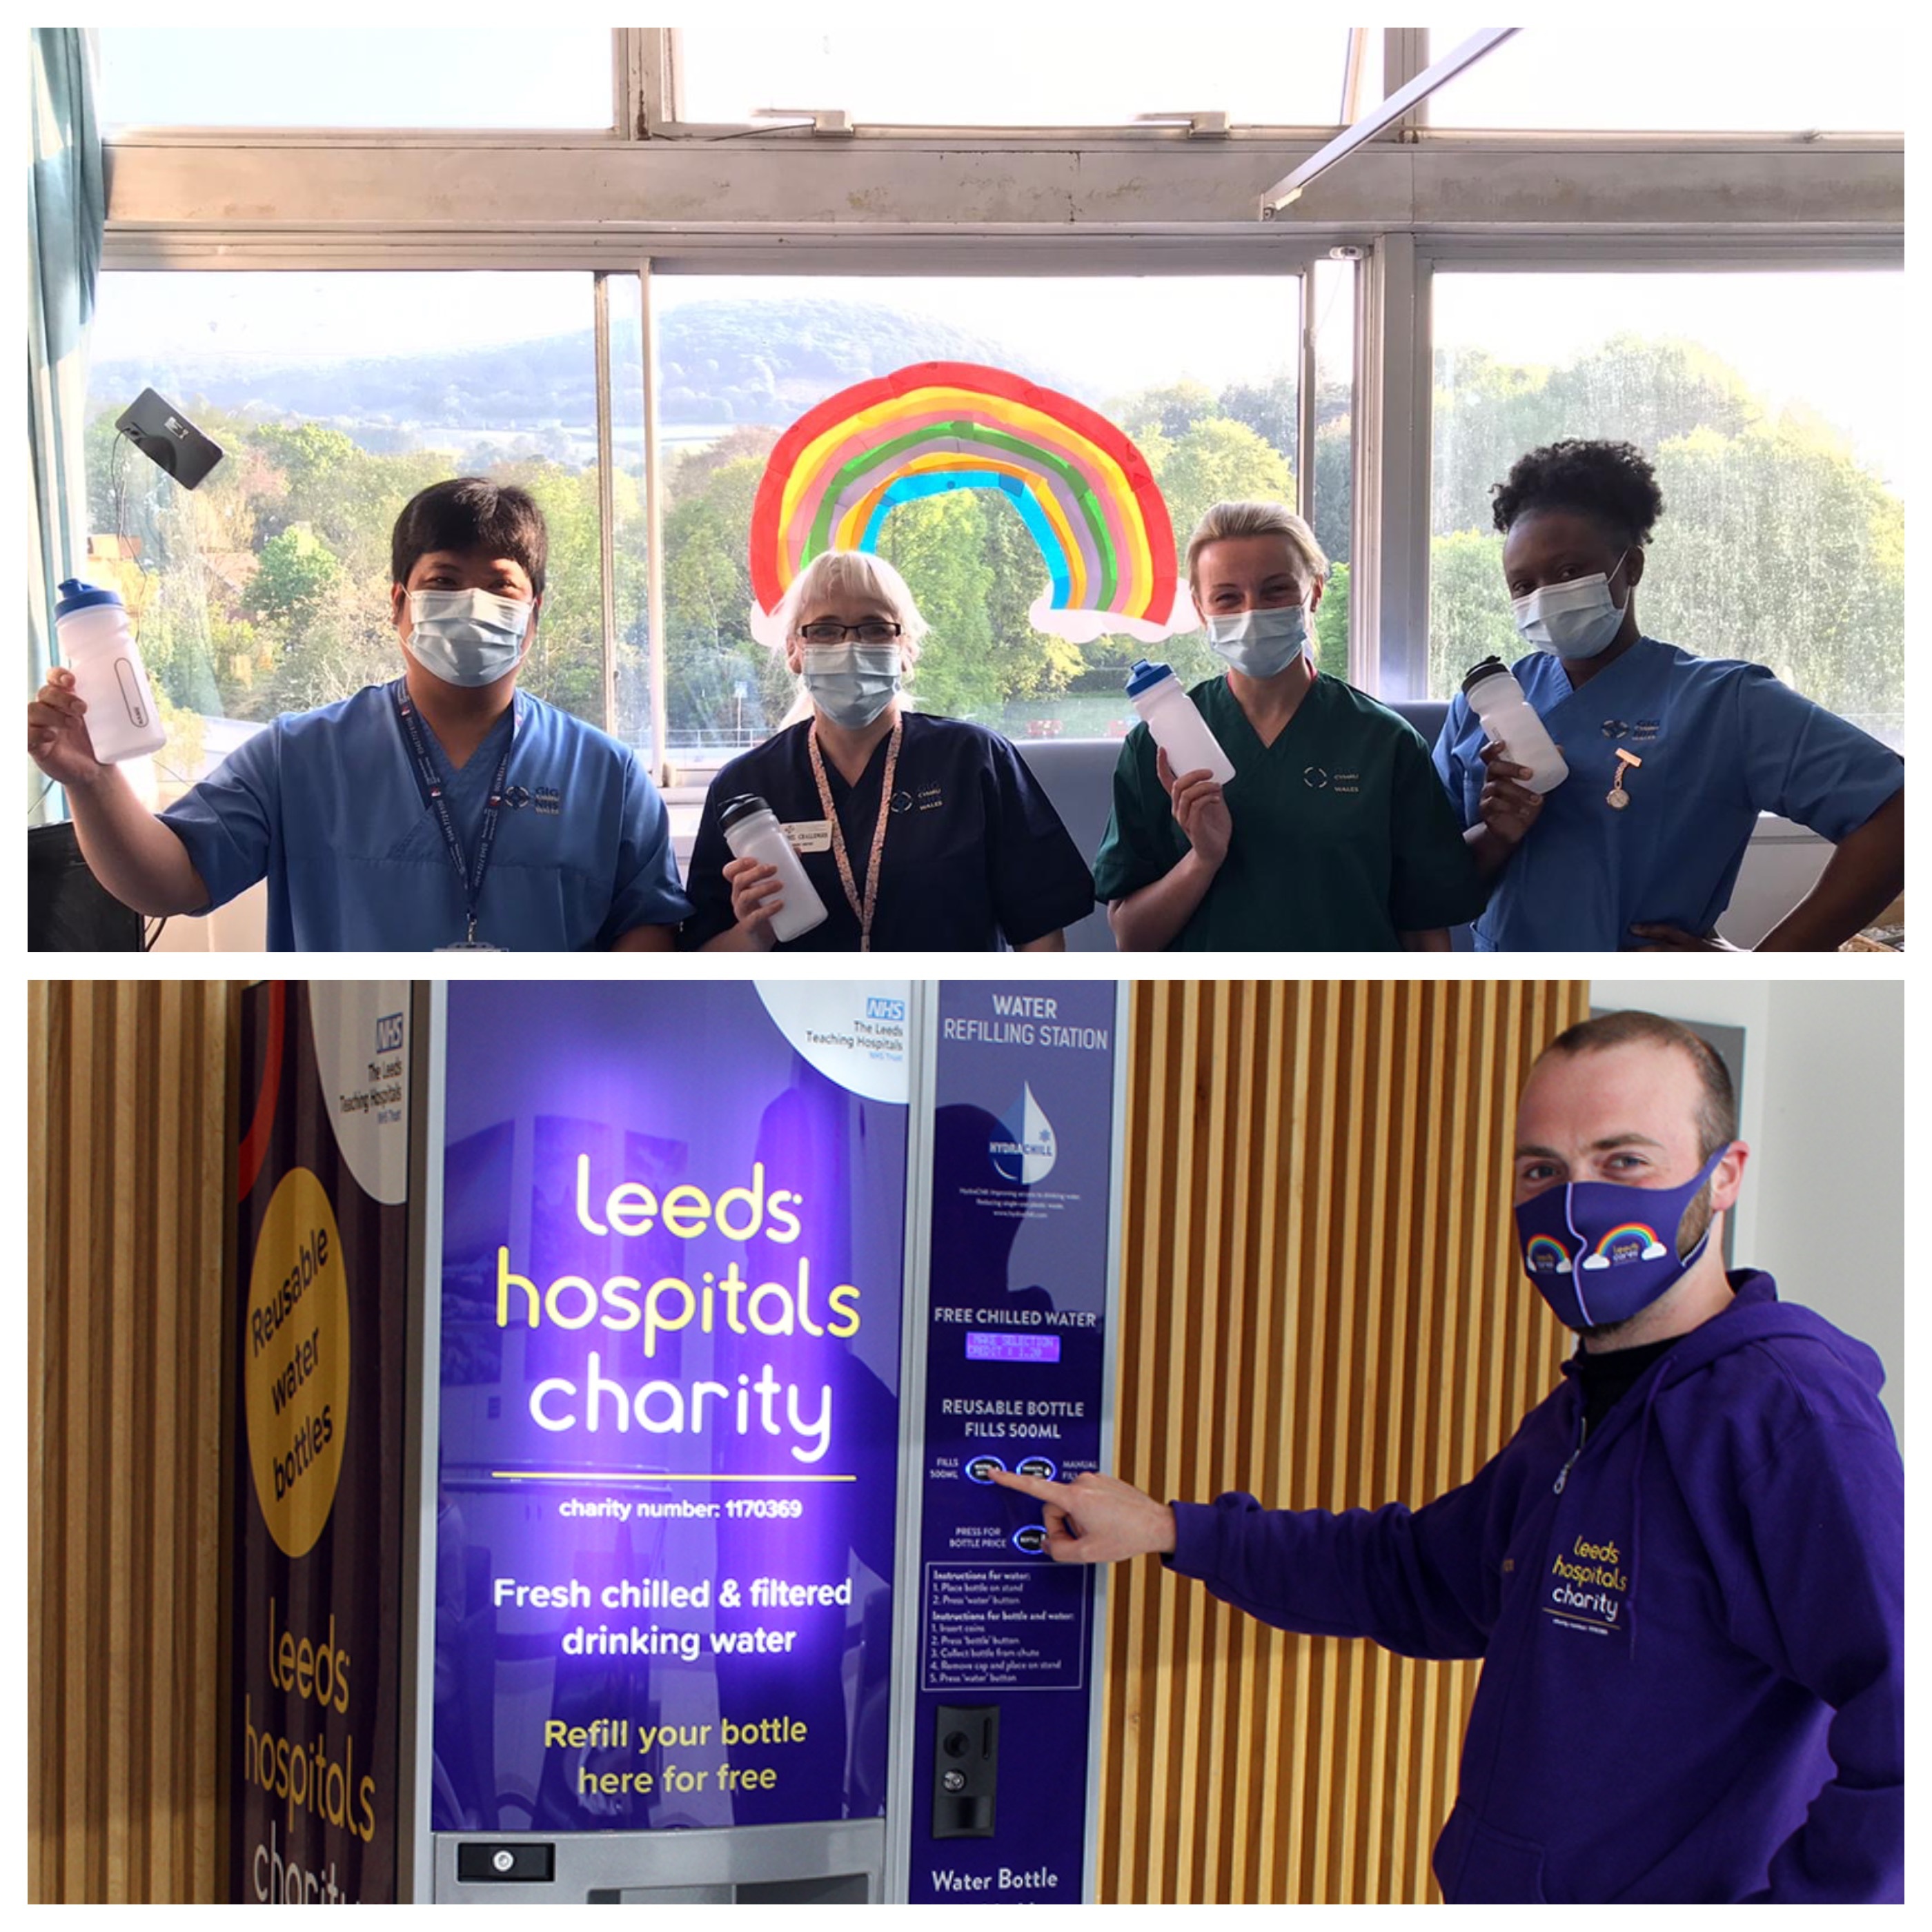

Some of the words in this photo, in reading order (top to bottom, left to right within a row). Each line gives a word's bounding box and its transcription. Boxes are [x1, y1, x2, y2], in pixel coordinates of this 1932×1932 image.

[869, 999, 903, 1019] NHS
[992, 994, 1058, 1018] WATER
[377, 1017, 403, 1050] NHS
[806, 1029, 854, 1049] Teaching
[856, 1036, 903, 1051] Hospitals
[854, 1021, 873, 1034] The
[876, 1023, 903, 1036] Leeds
[943, 1018, 1035, 1045] REFILLING
[1039, 1026, 1109, 1049] STATION
[368, 1062, 381, 1082] The
[382, 1057, 402, 1080] Leeds
[339, 1090, 369, 1114] Teaching
[370, 1083, 402, 1108] Hospitals
[989, 1142, 1053, 1156] HYDRACHILL
[577, 1154, 802, 1243] leeds
[251, 1227, 328, 1359] Reusable
[496, 1245, 860, 1358] hospitals
[934, 1307, 973, 1323] FREE
[976, 1309, 1042, 1325] CHILLED
[1045, 1312, 1096, 1328] WATER
[270, 1326, 321, 1416] water
[529, 1350, 832, 1463] charity
[942, 1399, 1023, 1415] REUSABLE
[1027, 1401, 1085, 1417] BOTTLE
[965, 1422, 1006, 1437] FILLS
[1009, 1423, 1062, 1439] 500ML
[273, 1403, 333, 1502] bottles
[937, 1458, 958, 1468] FILLS
[559, 1498, 631, 1521] charity
[638, 1500, 720, 1517] number:
[726, 1499, 802, 1519] 1170369
[949, 1539, 980, 1548] BOTTLE
[981, 1539, 1007, 1548] PRICE
[955, 1527, 981, 1537] PRESS
[983, 1528, 1001, 1537] FOR
[1574, 1535, 1620, 1565] leeds
[933, 1570, 987, 1580] Instructions
[988, 1570, 1001, 1580] for
[1552, 1554, 1628, 1592] hospitals
[493, 1579, 591, 1609] Fresh
[601, 1579, 710, 1609] chilled
[718, 1580, 741, 1608] &
[750, 1577, 852, 1606] filtered
[940, 1583, 962, 1592] Place
[964, 1583, 987, 1592] bottle
[1002, 1583, 1023, 1592] stand
[943, 1595, 964, 1604] Press
[993, 1596, 1021, 1604] button
[1552, 1583, 1618, 1622] charity
[932, 1610, 985, 1621] Instructions
[987, 1610, 1000, 1621] for
[1002, 1610, 1027, 1621] bottle
[1030, 1610, 1047, 1621] and
[939, 1623, 963, 1633] Insert
[965, 1624, 985, 1633] coins
[941, 1635, 962, 1645] Press
[992, 1636, 1021, 1645] button
[269, 1596, 351, 1714] leeds
[562, 1625, 701, 1662] drinking
[710, 1627, 797, 1654] water
[940, 1648, 969, 1657] Collect
[970, 1648, 994, 1657] bottle
[996, 1648, 1015, 1657] from
[1016, 1648, 1040, 1657] chute
[939, 1673, 960, 1682] Press
[989, 1673, 1018, 1682] button
[940, 1660, 972, 1669] Remove
[974, 1663, 989, 1673] cap
[989, 1660, 1005, 1669] and
[1006, 1660, 1026, 1673] place
[1041, 1660, 1062, 1669] stand
[544, 1719, 628, 1748] Refill
[638, 1722, 712, 1754] your
[721, 1716, 808, 1744] bottle
[244, 1693, 375, 1843] hospitals
[578, 1767, 654, 1795] here
[662, 1765, 709, 1793] for
[717, 1764, 778, 1791] free
[931, 1871, 992, 1892] Water
[998, 1866, 1058, 1889] Bottle
